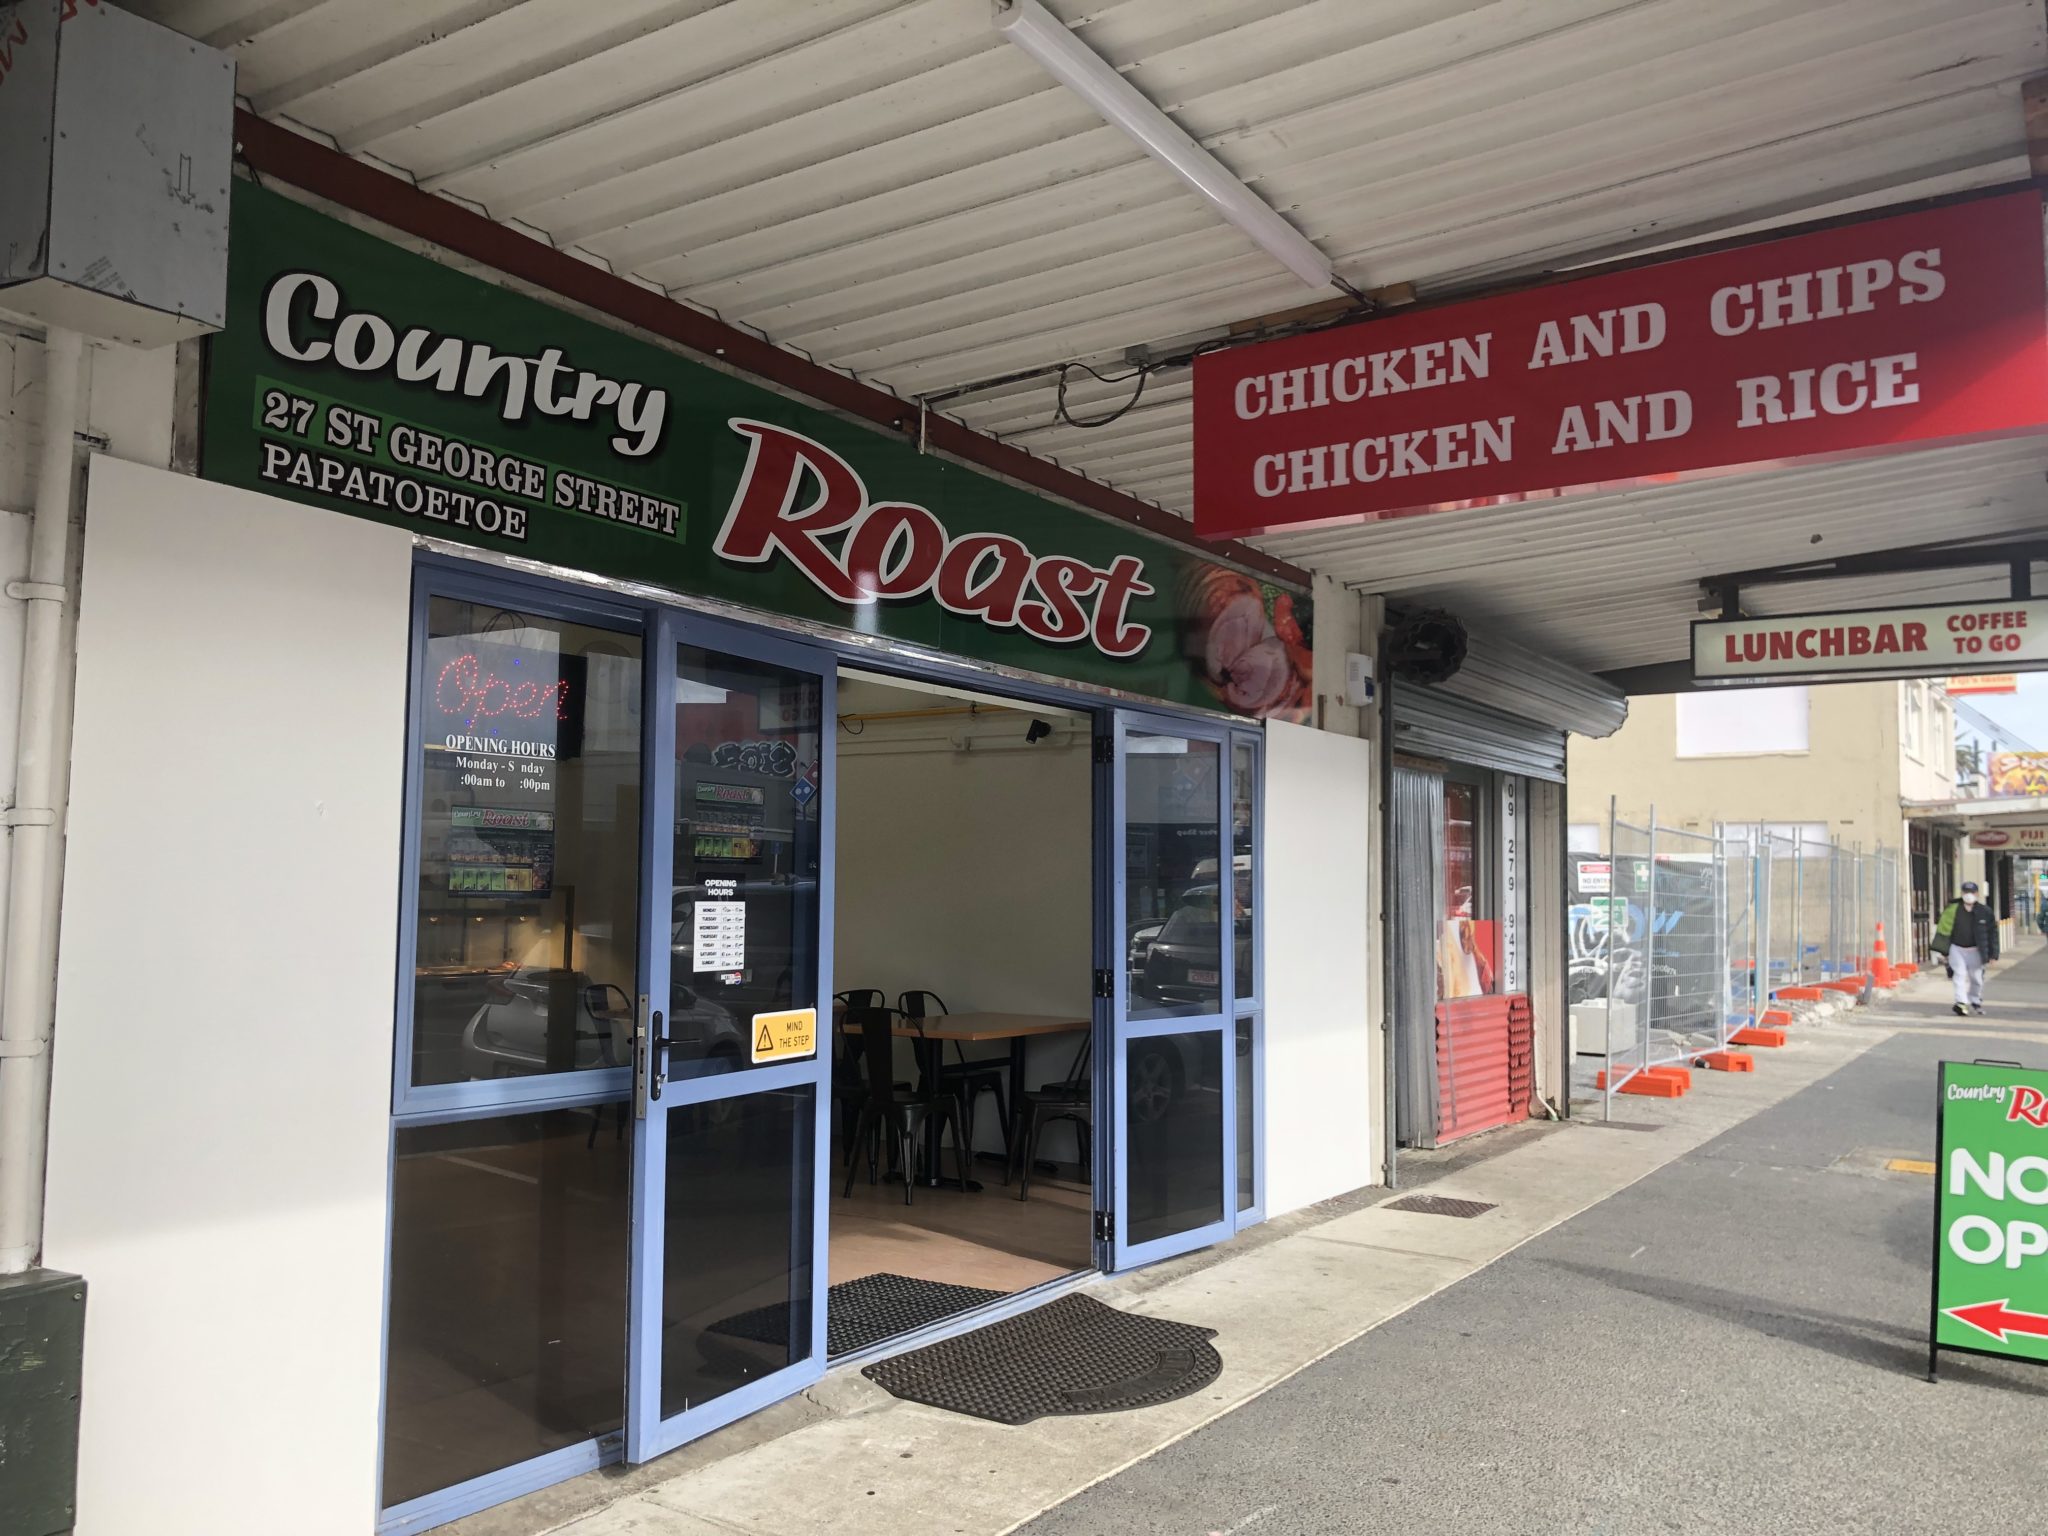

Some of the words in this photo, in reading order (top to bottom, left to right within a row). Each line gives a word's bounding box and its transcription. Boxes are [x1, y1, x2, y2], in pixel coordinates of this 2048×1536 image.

[1234, 332, 1493, 420] CHICKEN
[1528, 302, 1667, 369] AND
[1710, 248, 1945, 337] CHIPS
[266, 273, 666, 457] Country
[1252, 416, 1515, 497] CHICKEN
[1552, 389, 1693, 455] AND
[1736, 352, 1919, 430] RICE
[263, 391, 316, 434] 27
[328, 407, 379, 453] ST
[389, 426, 545, 500] GEORGE
[555, 472, 680, 536] STREET
[262, 442, 527, 540] PAPATOETOE
[712, 417, 1156, 657] Roast
[1947, 611, 2027, 633] COFFEE
[1725, 622, 1927, 663] LUNCHBAR
[1953, 636, 1982, 654] TO
[1988, 634, 2021, 652] GO
[436, 655, 569, 735] Open
[445, 734, 508, 754] OPENING
[511, 741, 556, 757] HOURS
[456, 756, 498, 774] Monday
[496, 777, 505, 787] to
[705, 880, 737, 888] OPENING
[708, 888, 734, 896] HOURS
[786, 1020, 803, 1032] MIND
[779, 1037, 792, 1048] THE
[794, 1035, 809, 1047] STEP
[1947, 1083, 2005, 1103] Country
